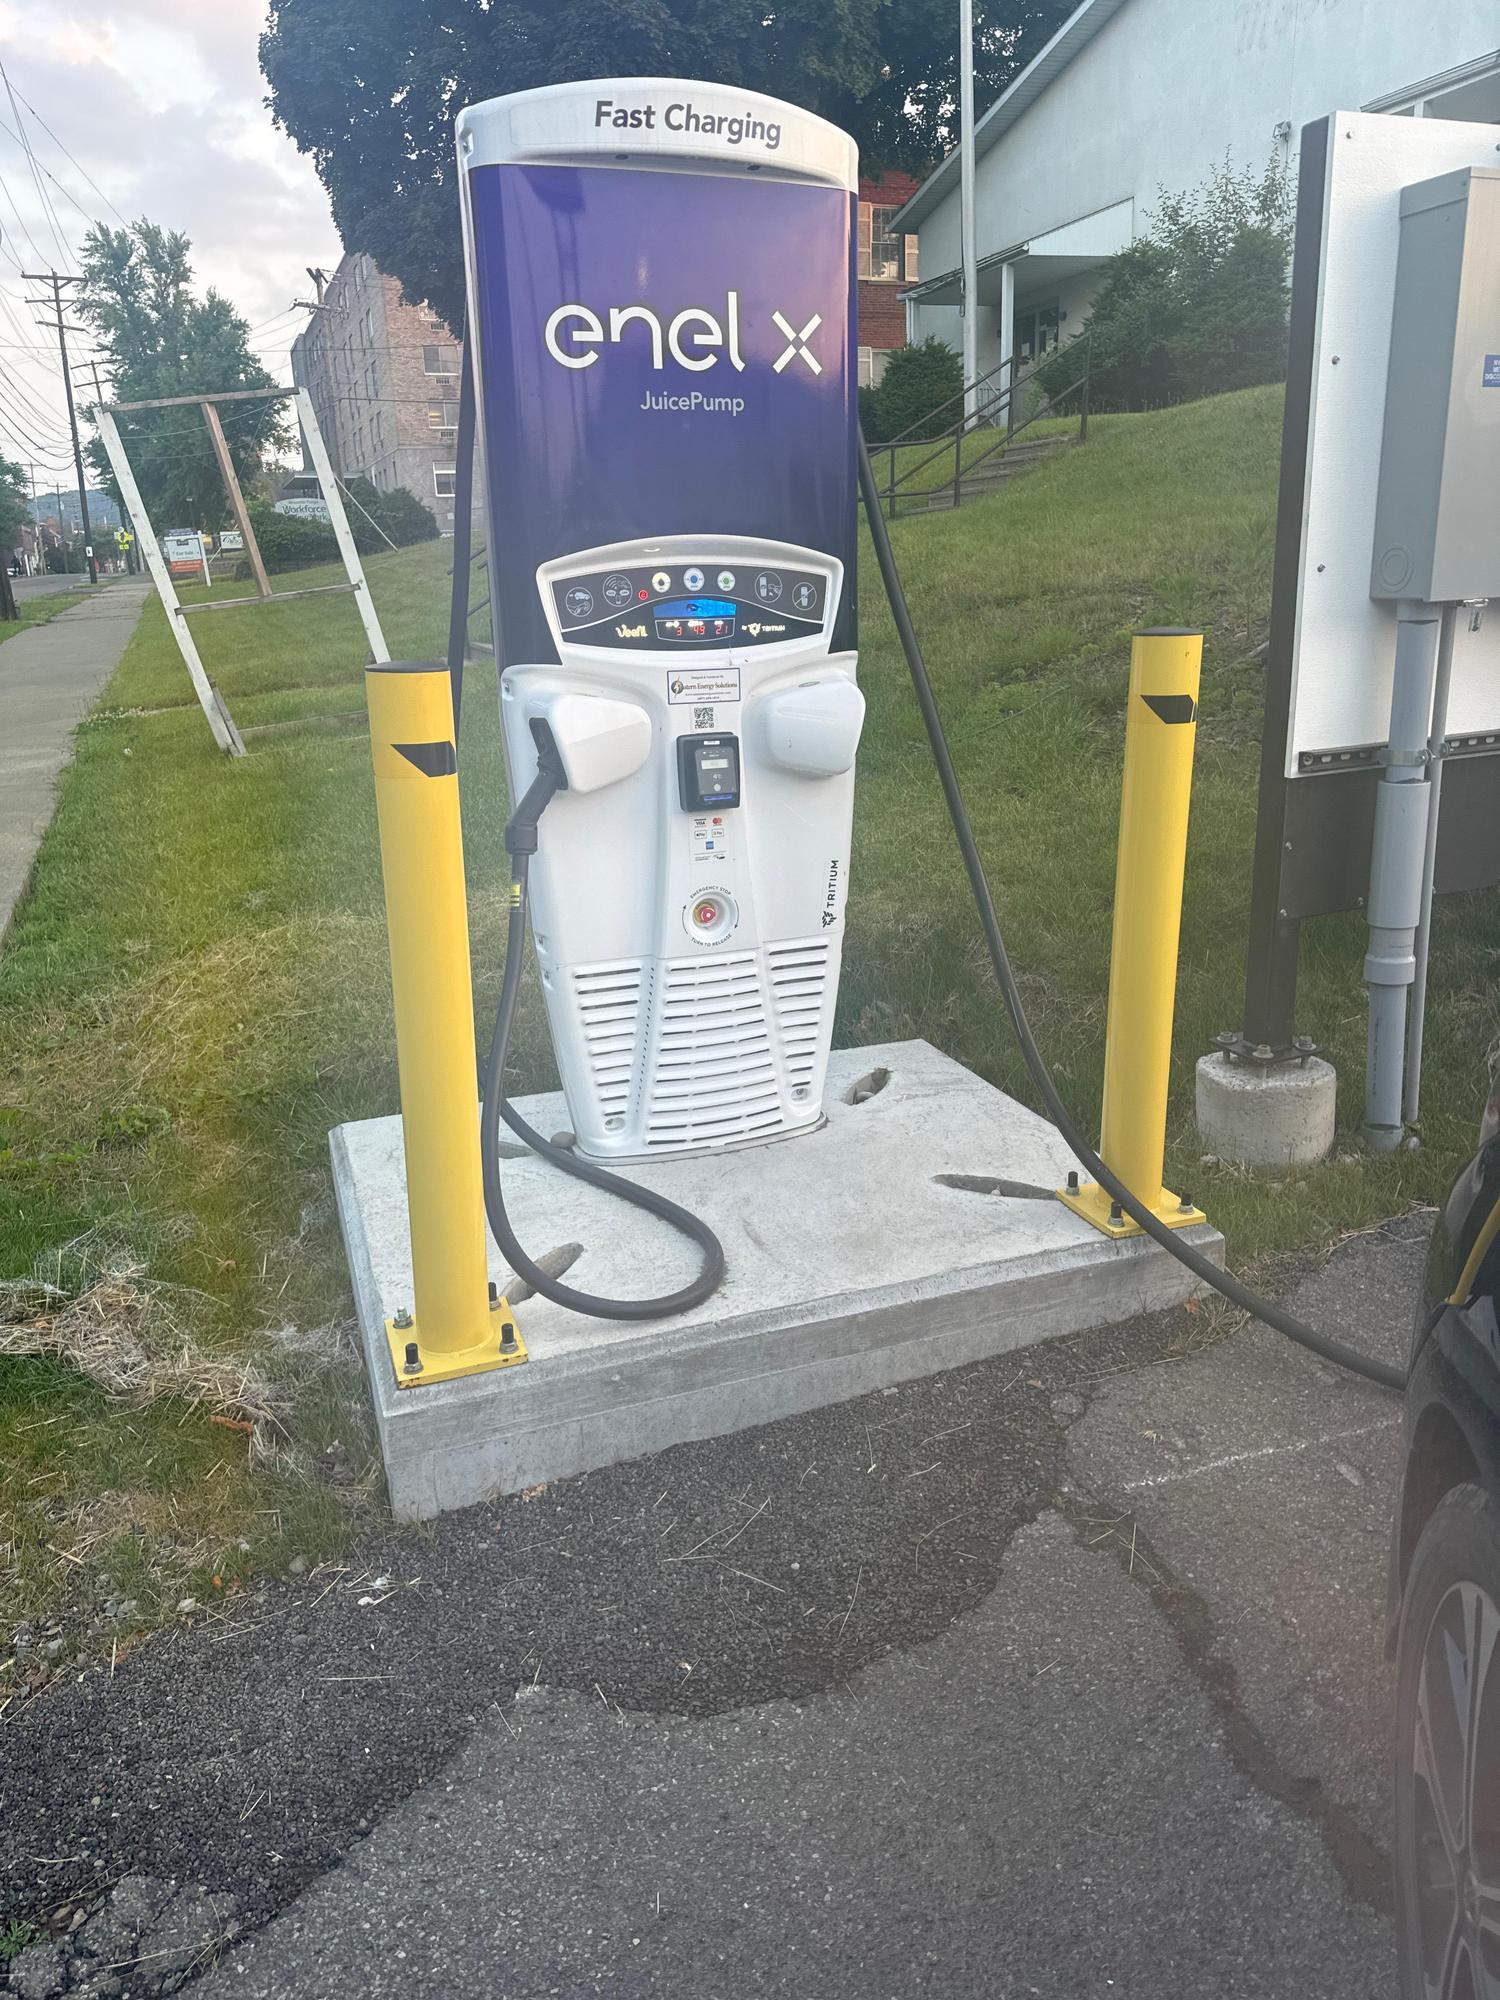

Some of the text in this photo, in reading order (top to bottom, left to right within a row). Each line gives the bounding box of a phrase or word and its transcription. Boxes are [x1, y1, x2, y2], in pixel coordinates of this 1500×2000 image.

[594, 100, 782, 149] Fast Charging
[545, 291, 823, 376] enel x
[640, 391, 745, 417] JuicePump
[281, 504, 327, 515] Workforce
[697, 682, 715, 691] Energy
[715, 680, 738, 689] Solutions
[690, 885, 731, 899] EMERGENCY STOP
[827, 859, 839, 909] TRITIUM
[691, 937, 704, 946] TURN
[712, 933, 732, 946] RELEASE
